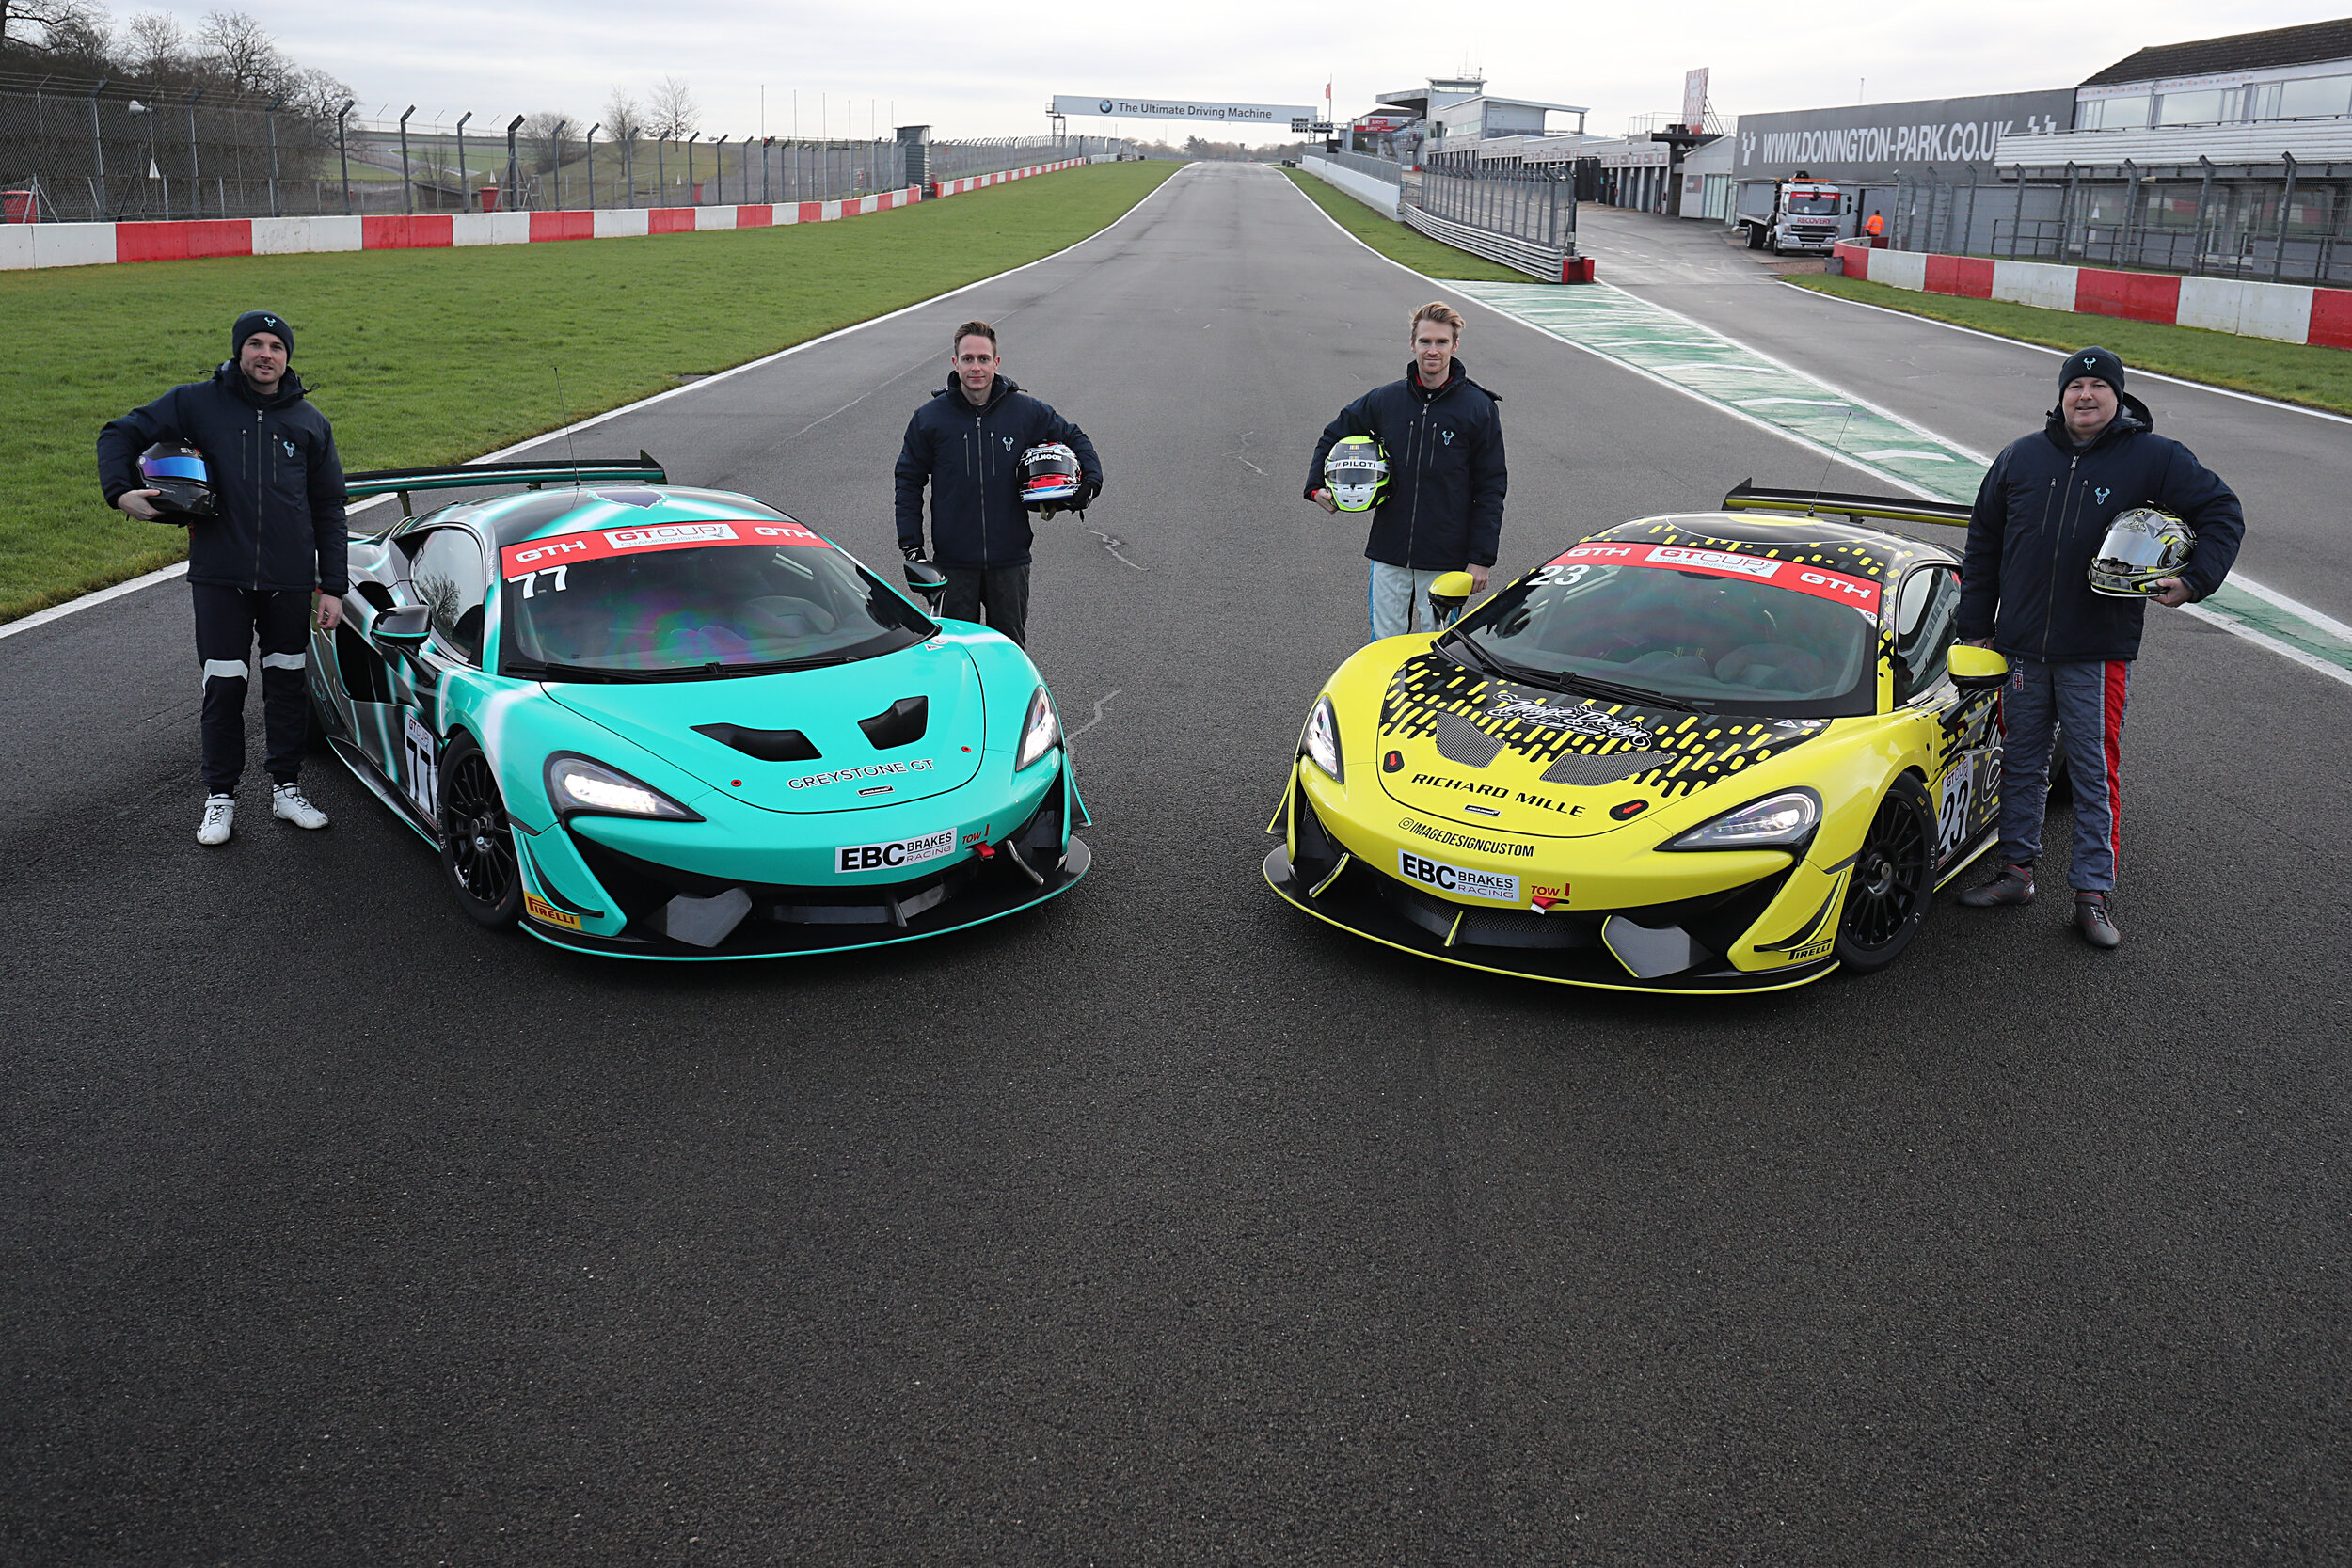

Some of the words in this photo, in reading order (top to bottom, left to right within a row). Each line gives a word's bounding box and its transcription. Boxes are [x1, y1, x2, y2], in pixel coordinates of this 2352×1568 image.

[1118, 103, 1137, 113] The
[1141, 103, 1184, 115] Ultimate
[1187, 105, 1225, 119] Driving
[1228, 107, 1272, 119] Machine
[621, 534, 706, 547] CHAMPIONSHIP
[754, 525, 818, 540] GTH
[515, 539, 588, 563] GTH
[1566, 546, 1632, 558] GTH
[1654, 556, 1739, 571] CHAMPIONSHIP
[507, 564, 568, 599] 77
[1524, 564, 1592, 587] 23
[1798, 571, 1872, 599] GTH
[406, 735, 436, 817] 77
[787, 761, 908, 790] GREYSTONE
[910, 758, 935, 770] GT
[1411, 773, 1509, 800] RICHARD
[1515, 792, 1586, 817] MILLE
[1938, 779, 1969, 857] 23
[907, 832, 952, 852] BRAKES
[962, 831, 982, 845] TOW
[841, 843, 905, 871] EBC
[906, 846, 952, 863] RACING
[1402, 852, 1456, 890] EBC
[1458, 871, 1514, 889] BRAKES
[1458, 885, 1514, 899] RACING
[1531, 885, 1560, 896] TOW
[527, 896, 576, 925] PIRELLI
[1788, 938, 1833, 961] PIRELLI
